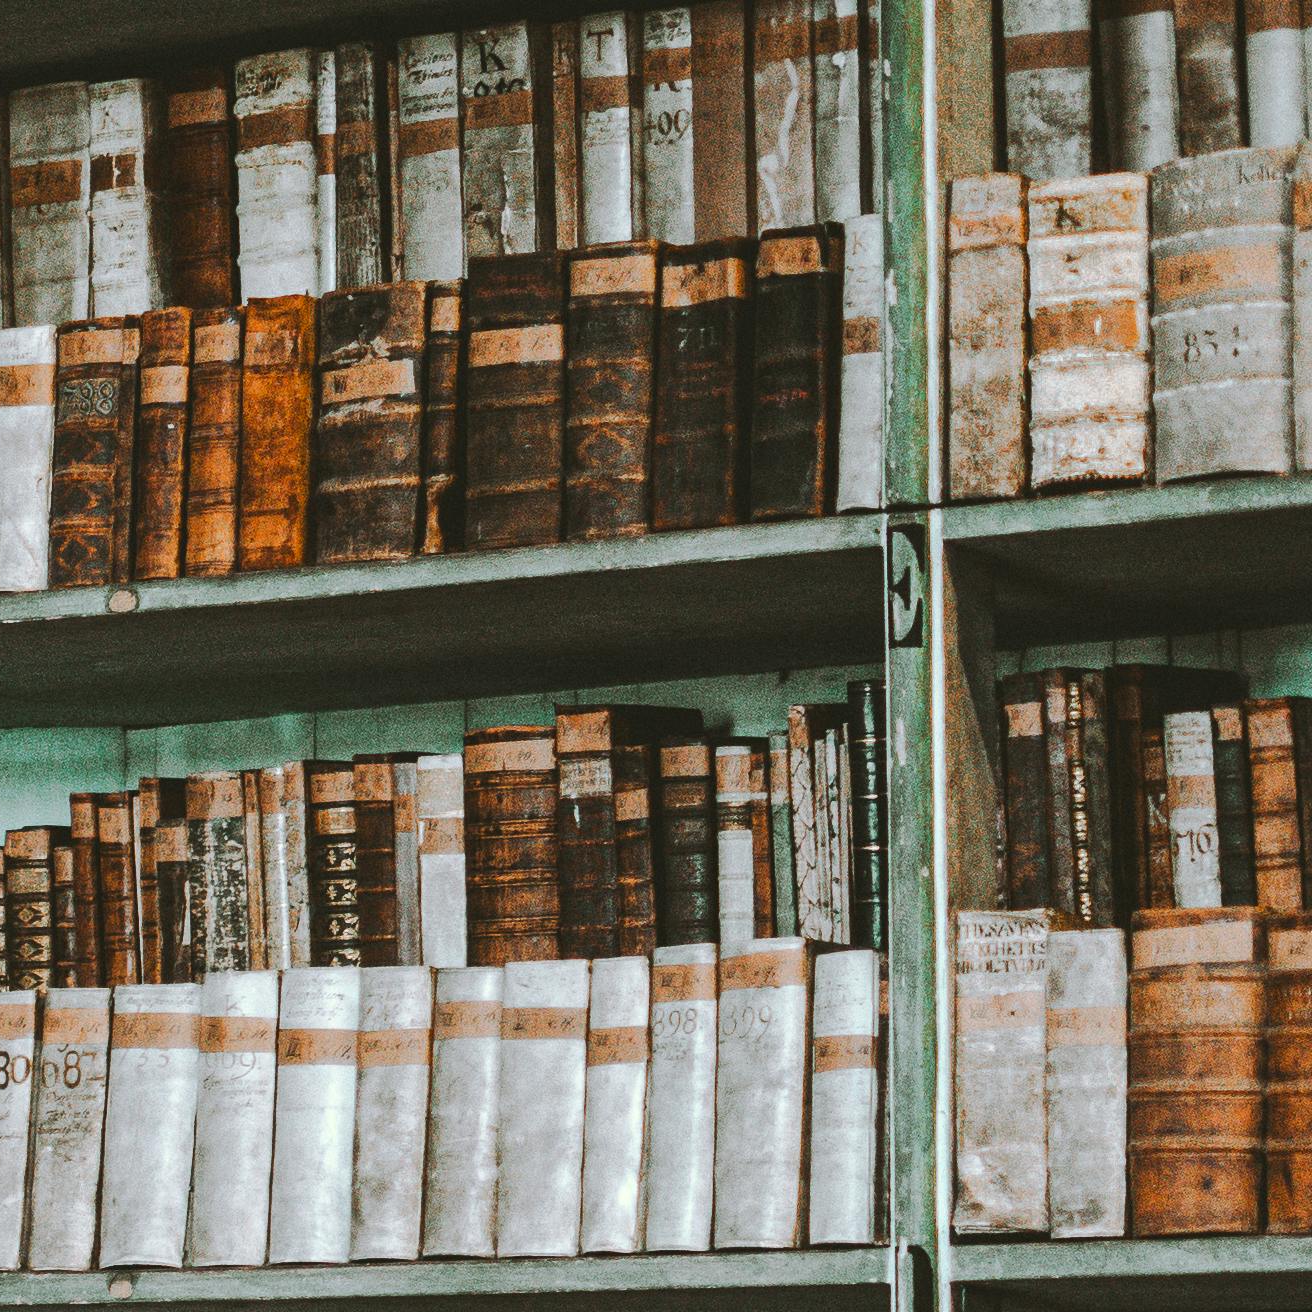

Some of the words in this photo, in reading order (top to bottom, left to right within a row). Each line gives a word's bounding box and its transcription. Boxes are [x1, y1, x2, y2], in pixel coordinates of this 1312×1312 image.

[480, 37, 509, 74] K
[1056, 199, 1082, 229] K
[889, 523, 924, 648] E
